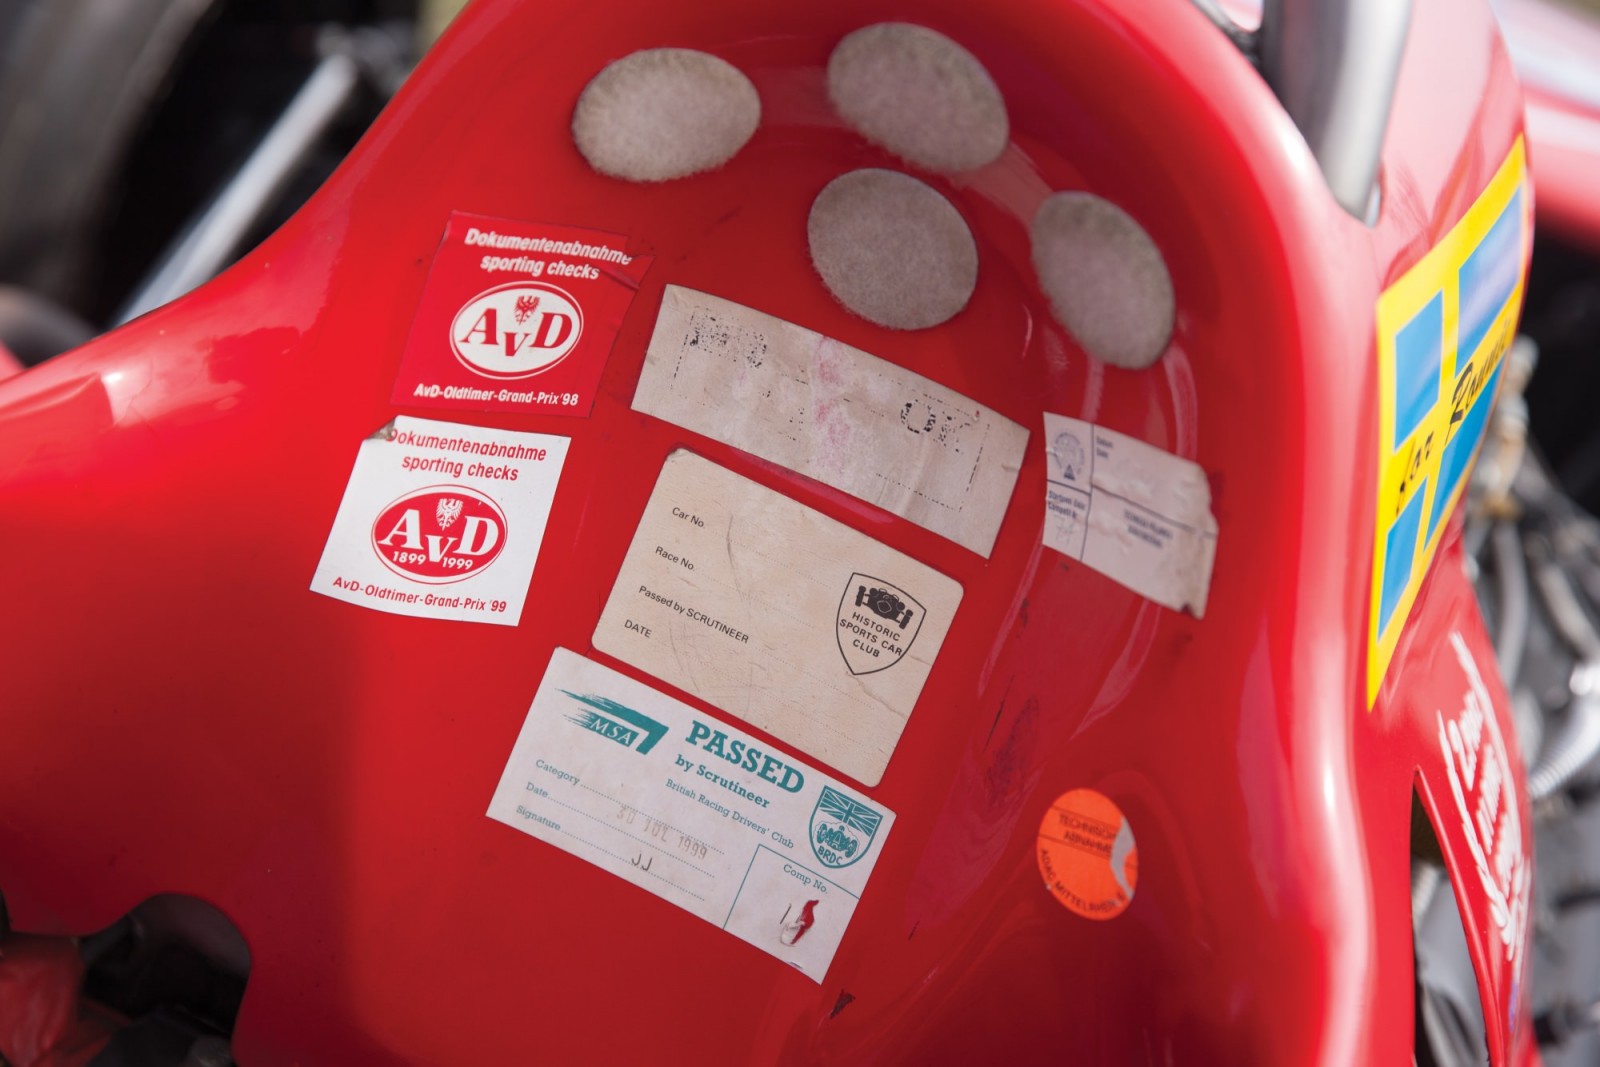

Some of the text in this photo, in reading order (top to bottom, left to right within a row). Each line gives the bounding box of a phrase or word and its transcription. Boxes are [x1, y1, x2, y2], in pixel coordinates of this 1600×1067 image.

[464, 228, 632, 265] Dokumentenabnahme
[480, 254, 599, 280] sporting checks
[402, 455, 519, 481] sporting checks
[672, 507, 690, 522] Car
[392, 551, 474, 570] 1899 1999
[655, 546, 696, 572] Race No.
[639, 585, 749, 644] Passed by SCRUTINEER
[852, 611, 901, 642] HISTORIC
[624, 619, 652, 638] DATE
[839, 618, 903, 656] SPORTS CAR
[852, 639, 881, 659] CLUB
[590, 718, 633, 745] MSA
[685, 720, 805, 793] PASSED
[536, 759, 580, 786] Category
[675, 754, 770, 809] by Scrutineer
[526, 781, 549, 799] Date
[516, 805, 561, 831] Signature
[665, 778, 696, 799] British
[698, 793, 731, 817] Racing
[771, 830, 794, 849] Club
[678, 835, 709, 859] 1999
[817, 846, 843, 866] BRDC
[783, 864, 829, 895] Comp No.
